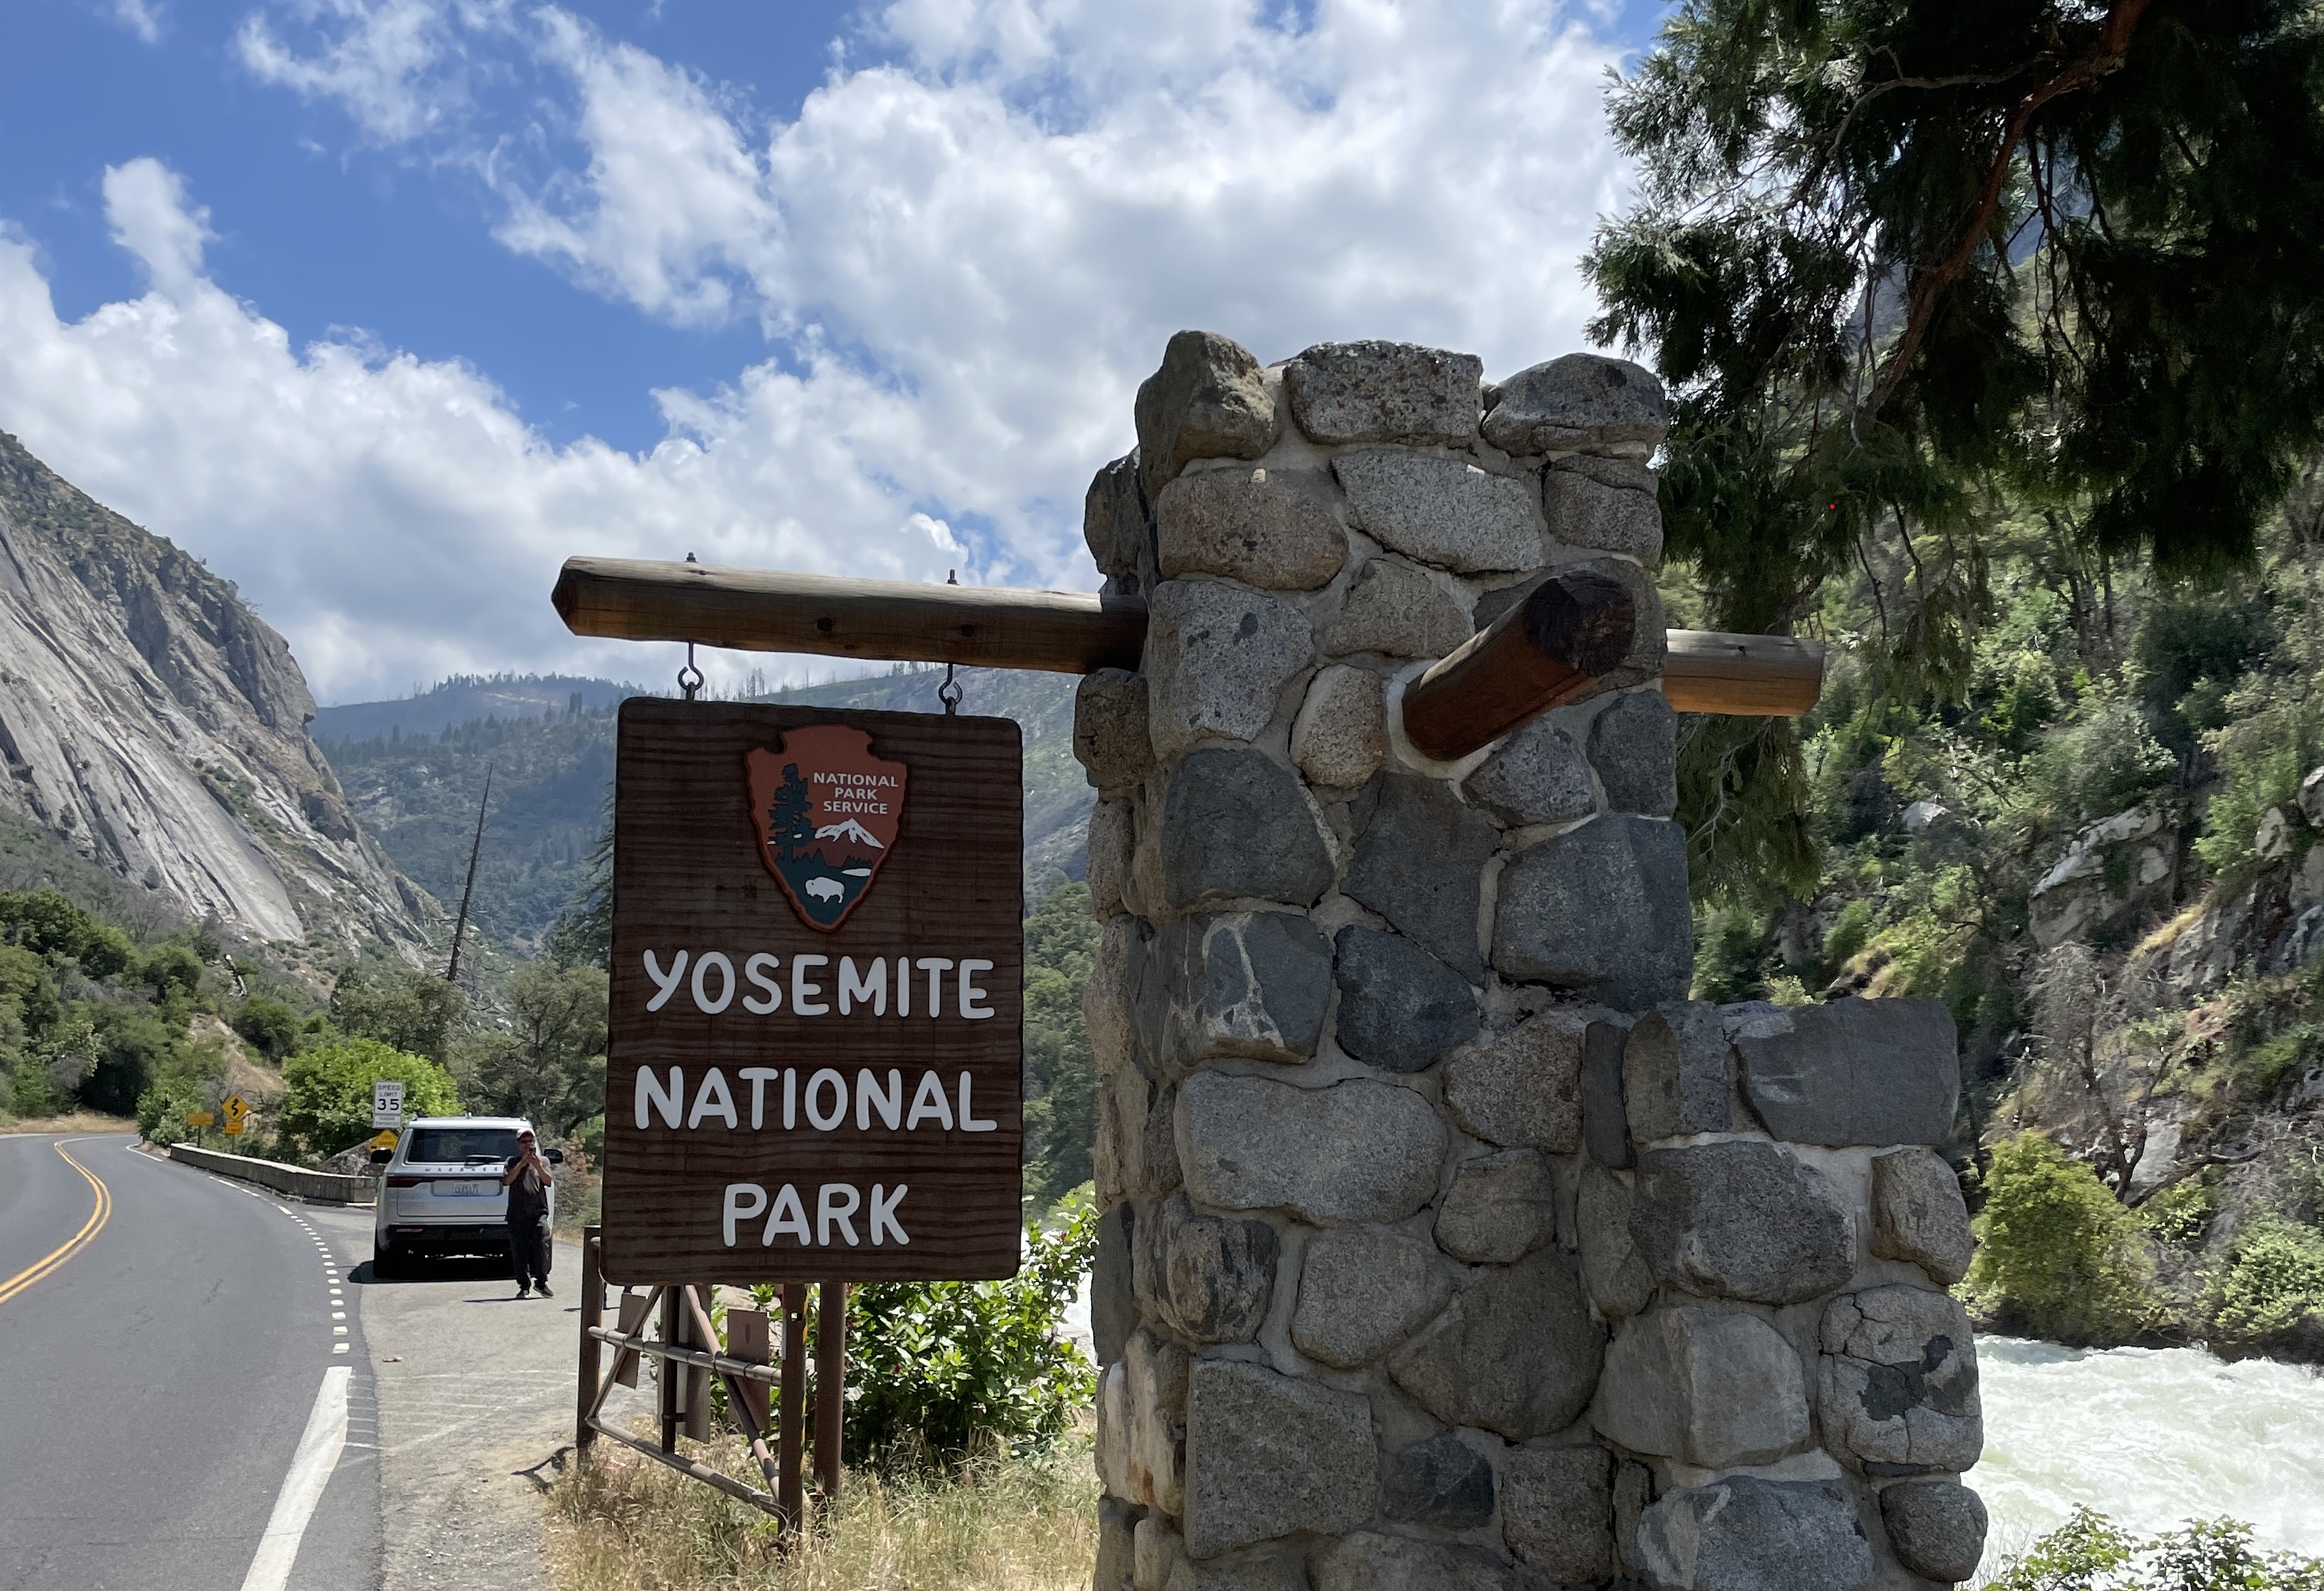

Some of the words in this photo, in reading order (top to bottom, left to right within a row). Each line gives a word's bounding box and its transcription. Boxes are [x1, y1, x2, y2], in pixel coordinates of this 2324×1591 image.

[813, 772, 899, 788] NATIONAL
[835, 787, 878, 800] PARK
[823, 800, 888, 815] SERVICE
[642, 948, 995, 1020] YOSEMITE
[377, 1098, 400, 1111] 35
[634, 1065, 998, 1132] NATIONAL
[722, 1183, 911, 1247] PARK
